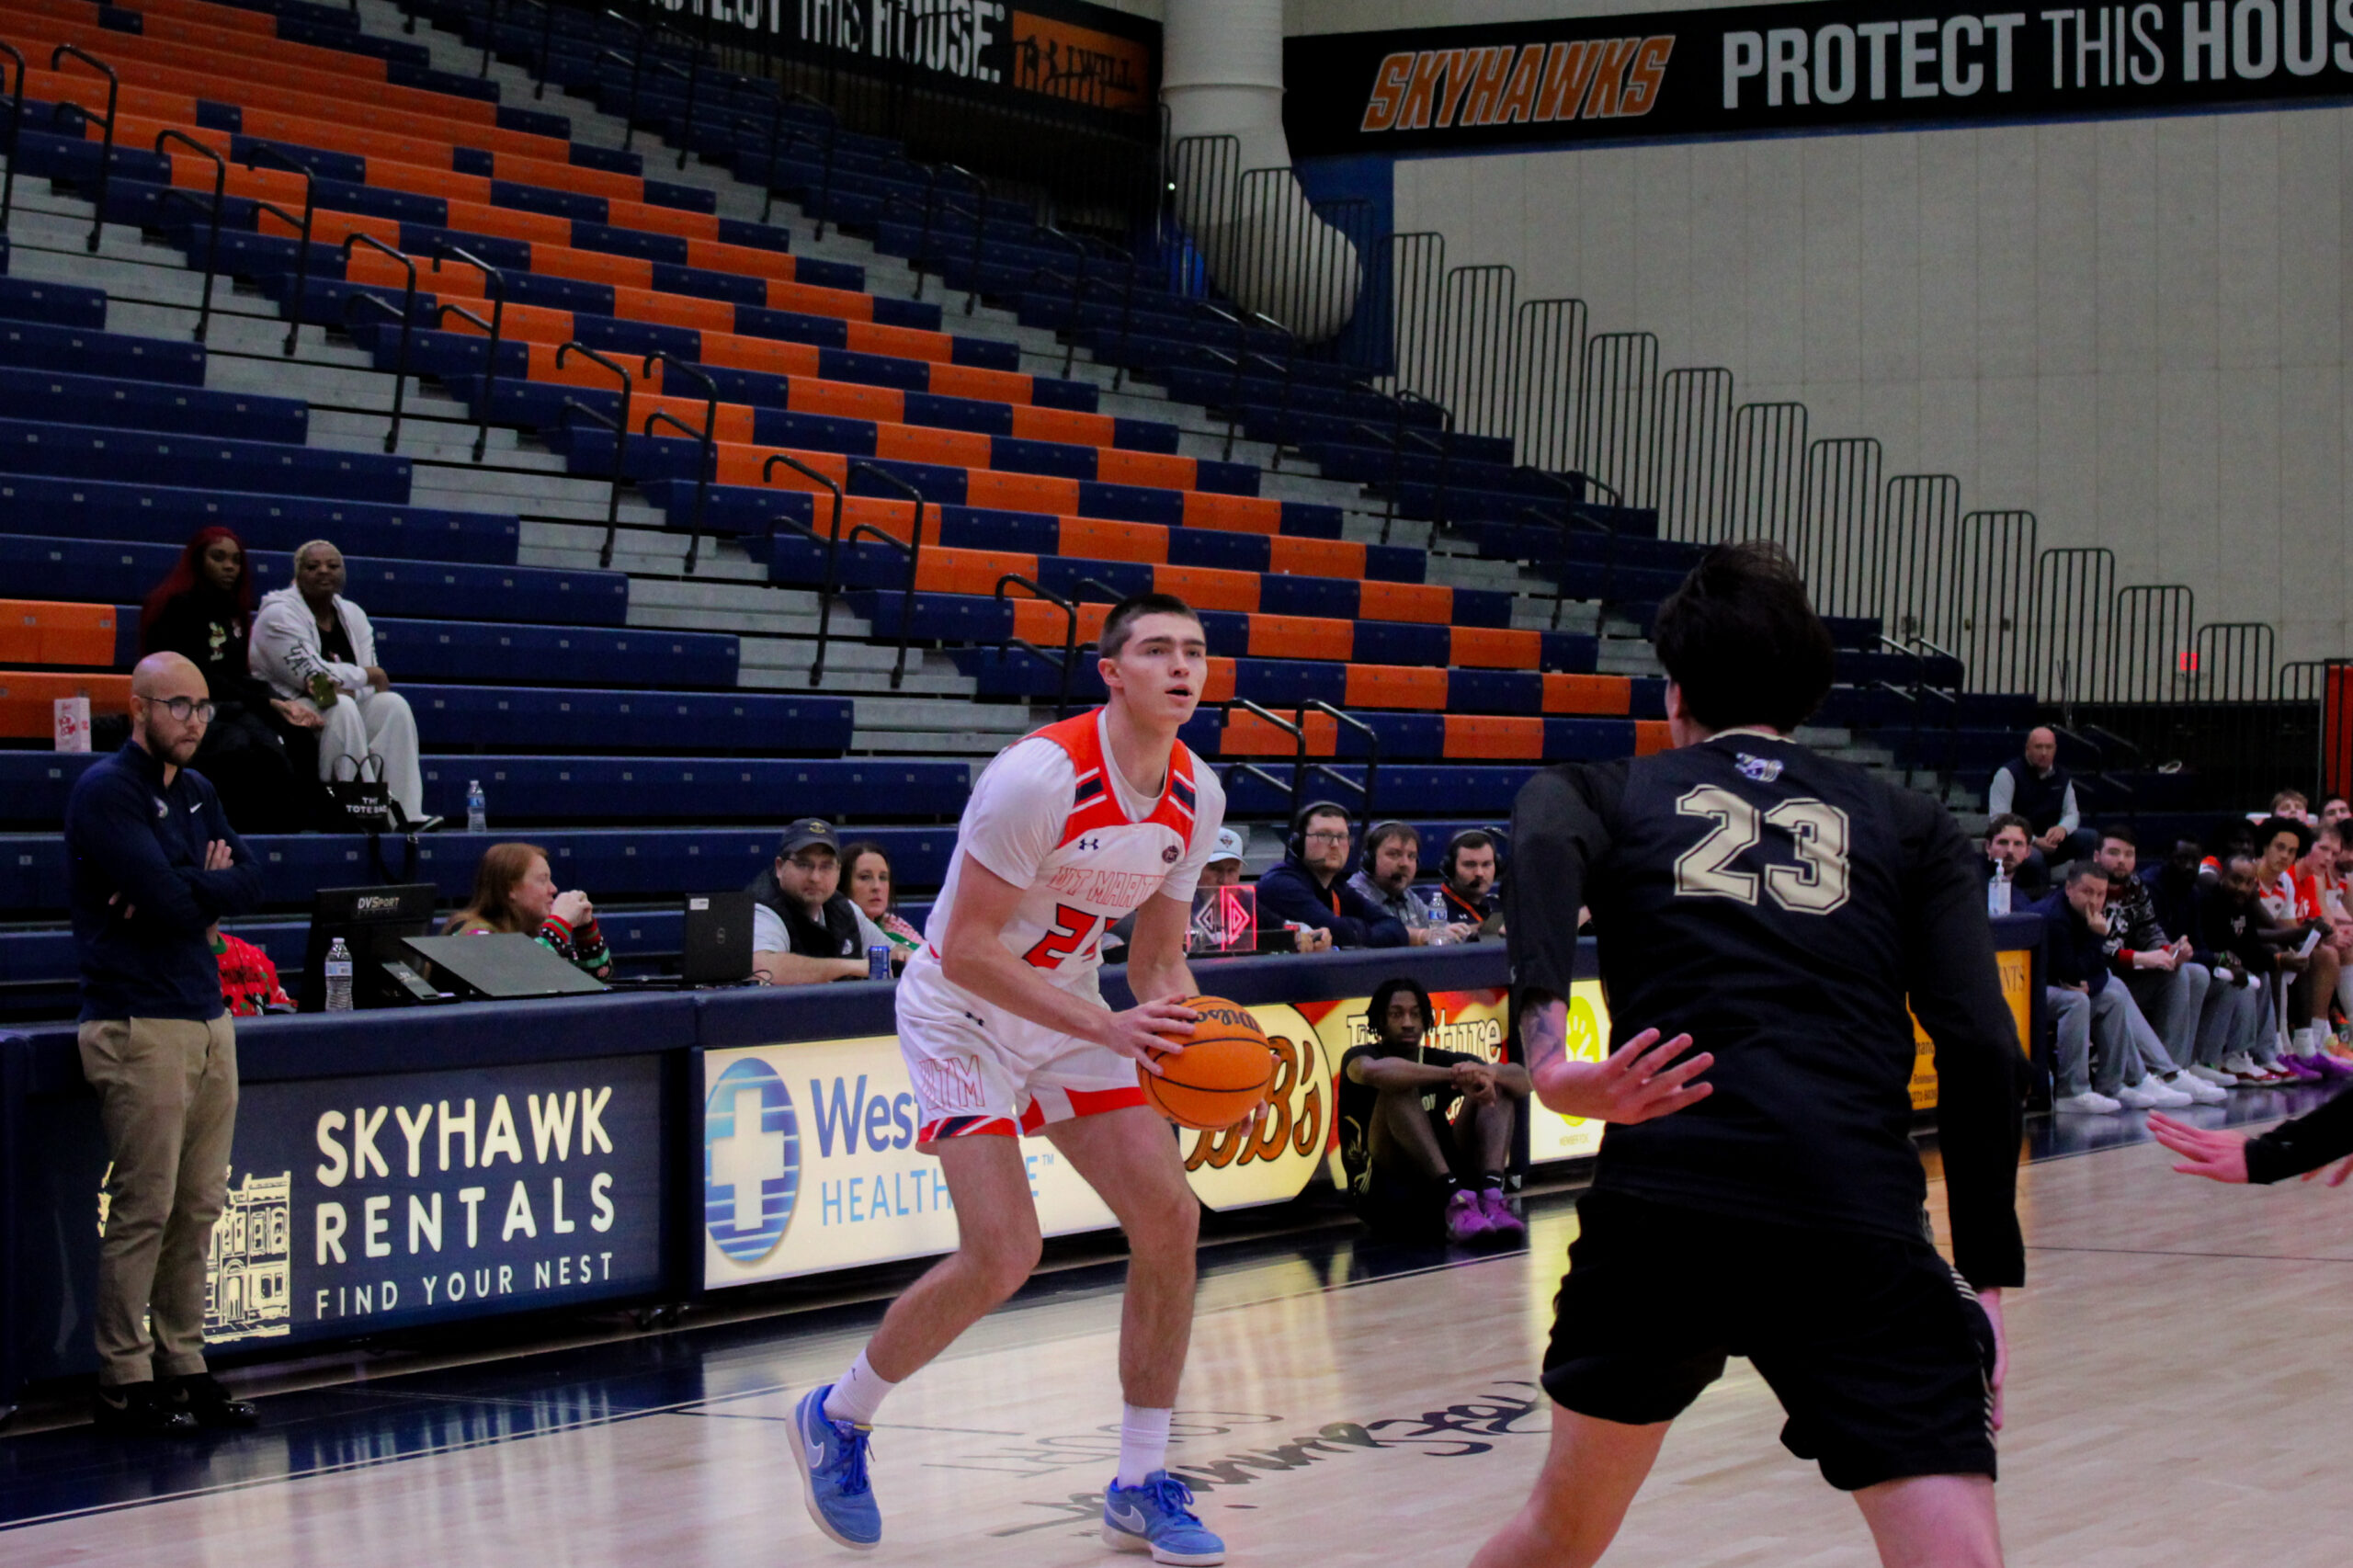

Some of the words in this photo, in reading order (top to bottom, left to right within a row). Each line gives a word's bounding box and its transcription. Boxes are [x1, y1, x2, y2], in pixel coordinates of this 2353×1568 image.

[1360, 35, 1676, 132] SKYHAWKS
[1723, 13, 2026, 109] PROTECT
[2041, 4, 2165, 89] THIS
[1086, 869, 1165, 908] MART
[1674, 783, 1850, 915] 23
[1021, 903, 1120, 970] 2
[1168, 1009, 1262, 1035] Wilso
[316, 1086, 613, 1187] SKYHAWK
[810, 1074, 919, 1158] Wes
[316, 1172, 615, 1266] RENTALS
[822, 1155, 1039, 1226] HEALTHE
[316, 1280, 398, 1320] FIND
[423, 1265, 513, 1302] YOUR
[535, 1252, 613, 1290] NEST
